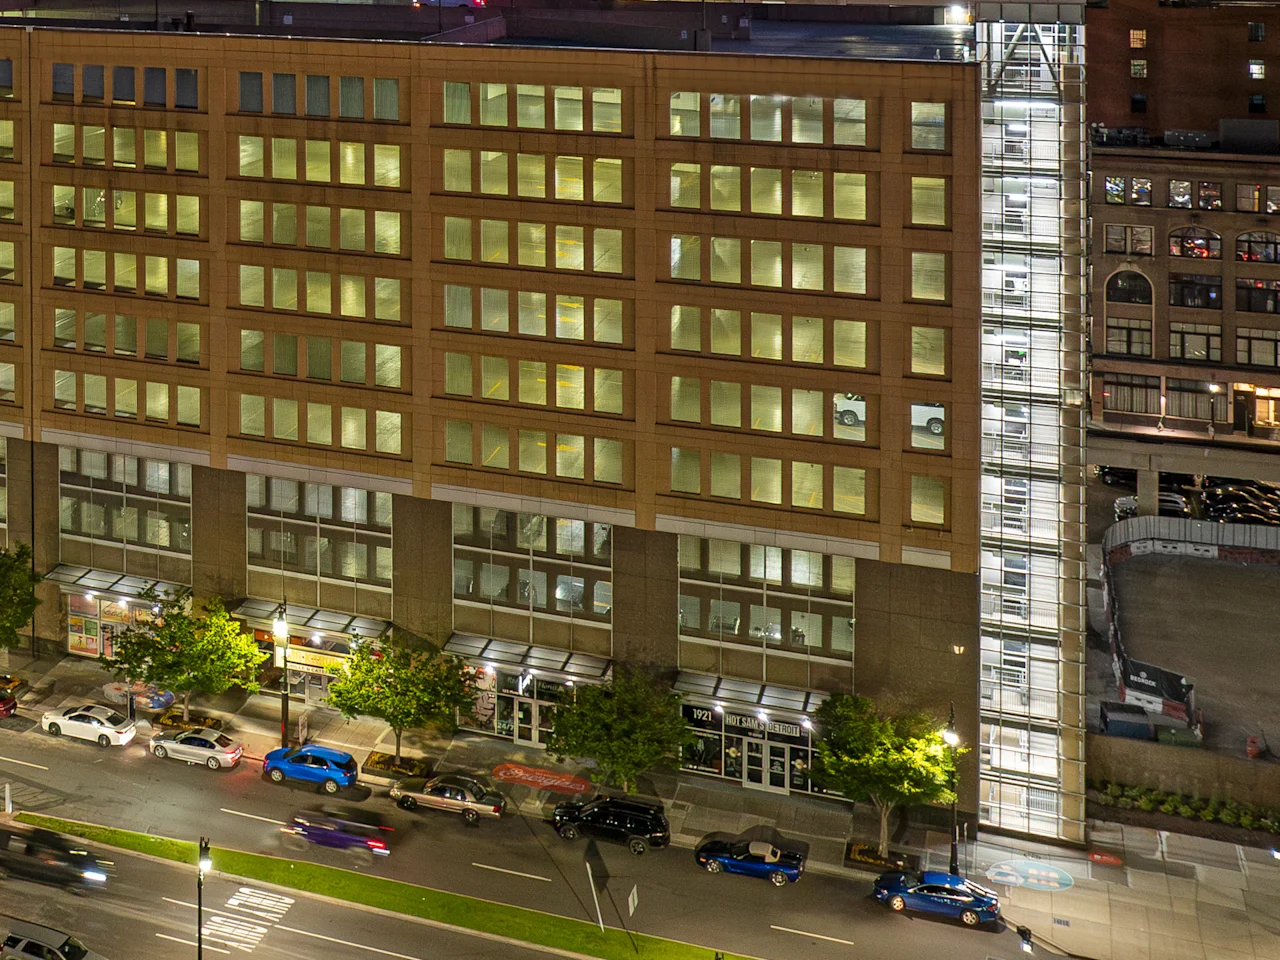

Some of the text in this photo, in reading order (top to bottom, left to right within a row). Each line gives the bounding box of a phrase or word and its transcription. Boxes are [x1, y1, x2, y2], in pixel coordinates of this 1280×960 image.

[1130, 674, 1157, 688] BEDROCK
[692, 708, 712, 721] 1921
[497, 721, 514, 731] 24/7
[726, 714, 799, 736] HOT SAMS DETROIT
[224, 887, 295, 922] ONLY
[196, 916, 268, 953] ONLY
